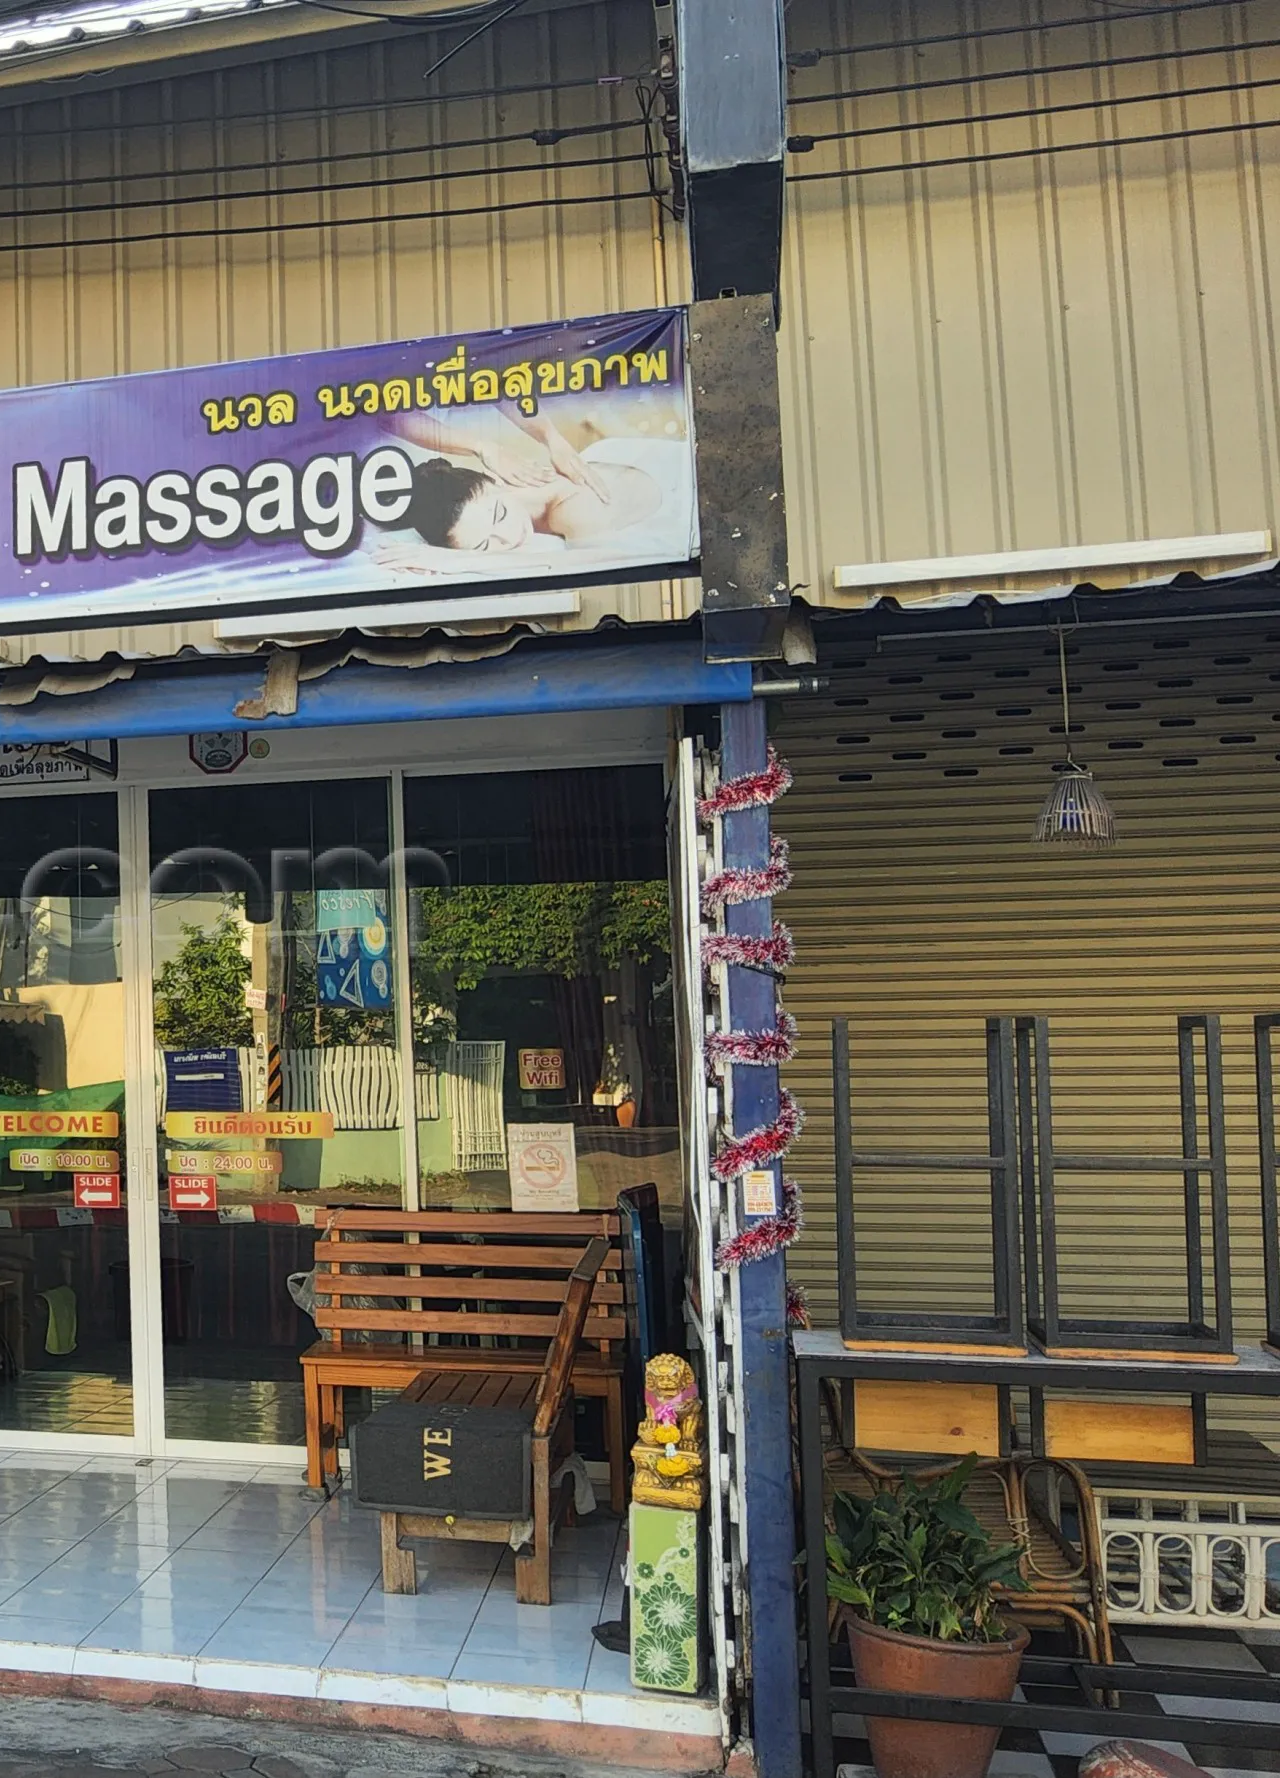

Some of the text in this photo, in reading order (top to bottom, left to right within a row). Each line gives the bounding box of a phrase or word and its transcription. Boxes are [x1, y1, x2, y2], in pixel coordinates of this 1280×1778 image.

[202, 345, 669, 433] นวล นวดเพื่อสุขภาพ
[13, 446, 417, 555] Massage
[522, 1053, 561, 1067] Free
[526, 1071, 558, 1085] Wifi
[56, 1154, 92, 1167] 10.00
[214, 1156, 252, 1169] 24.00
[79, 1176, 112, 1187] SLIDE
[174, 1179, 209, 1189] SLIDE
